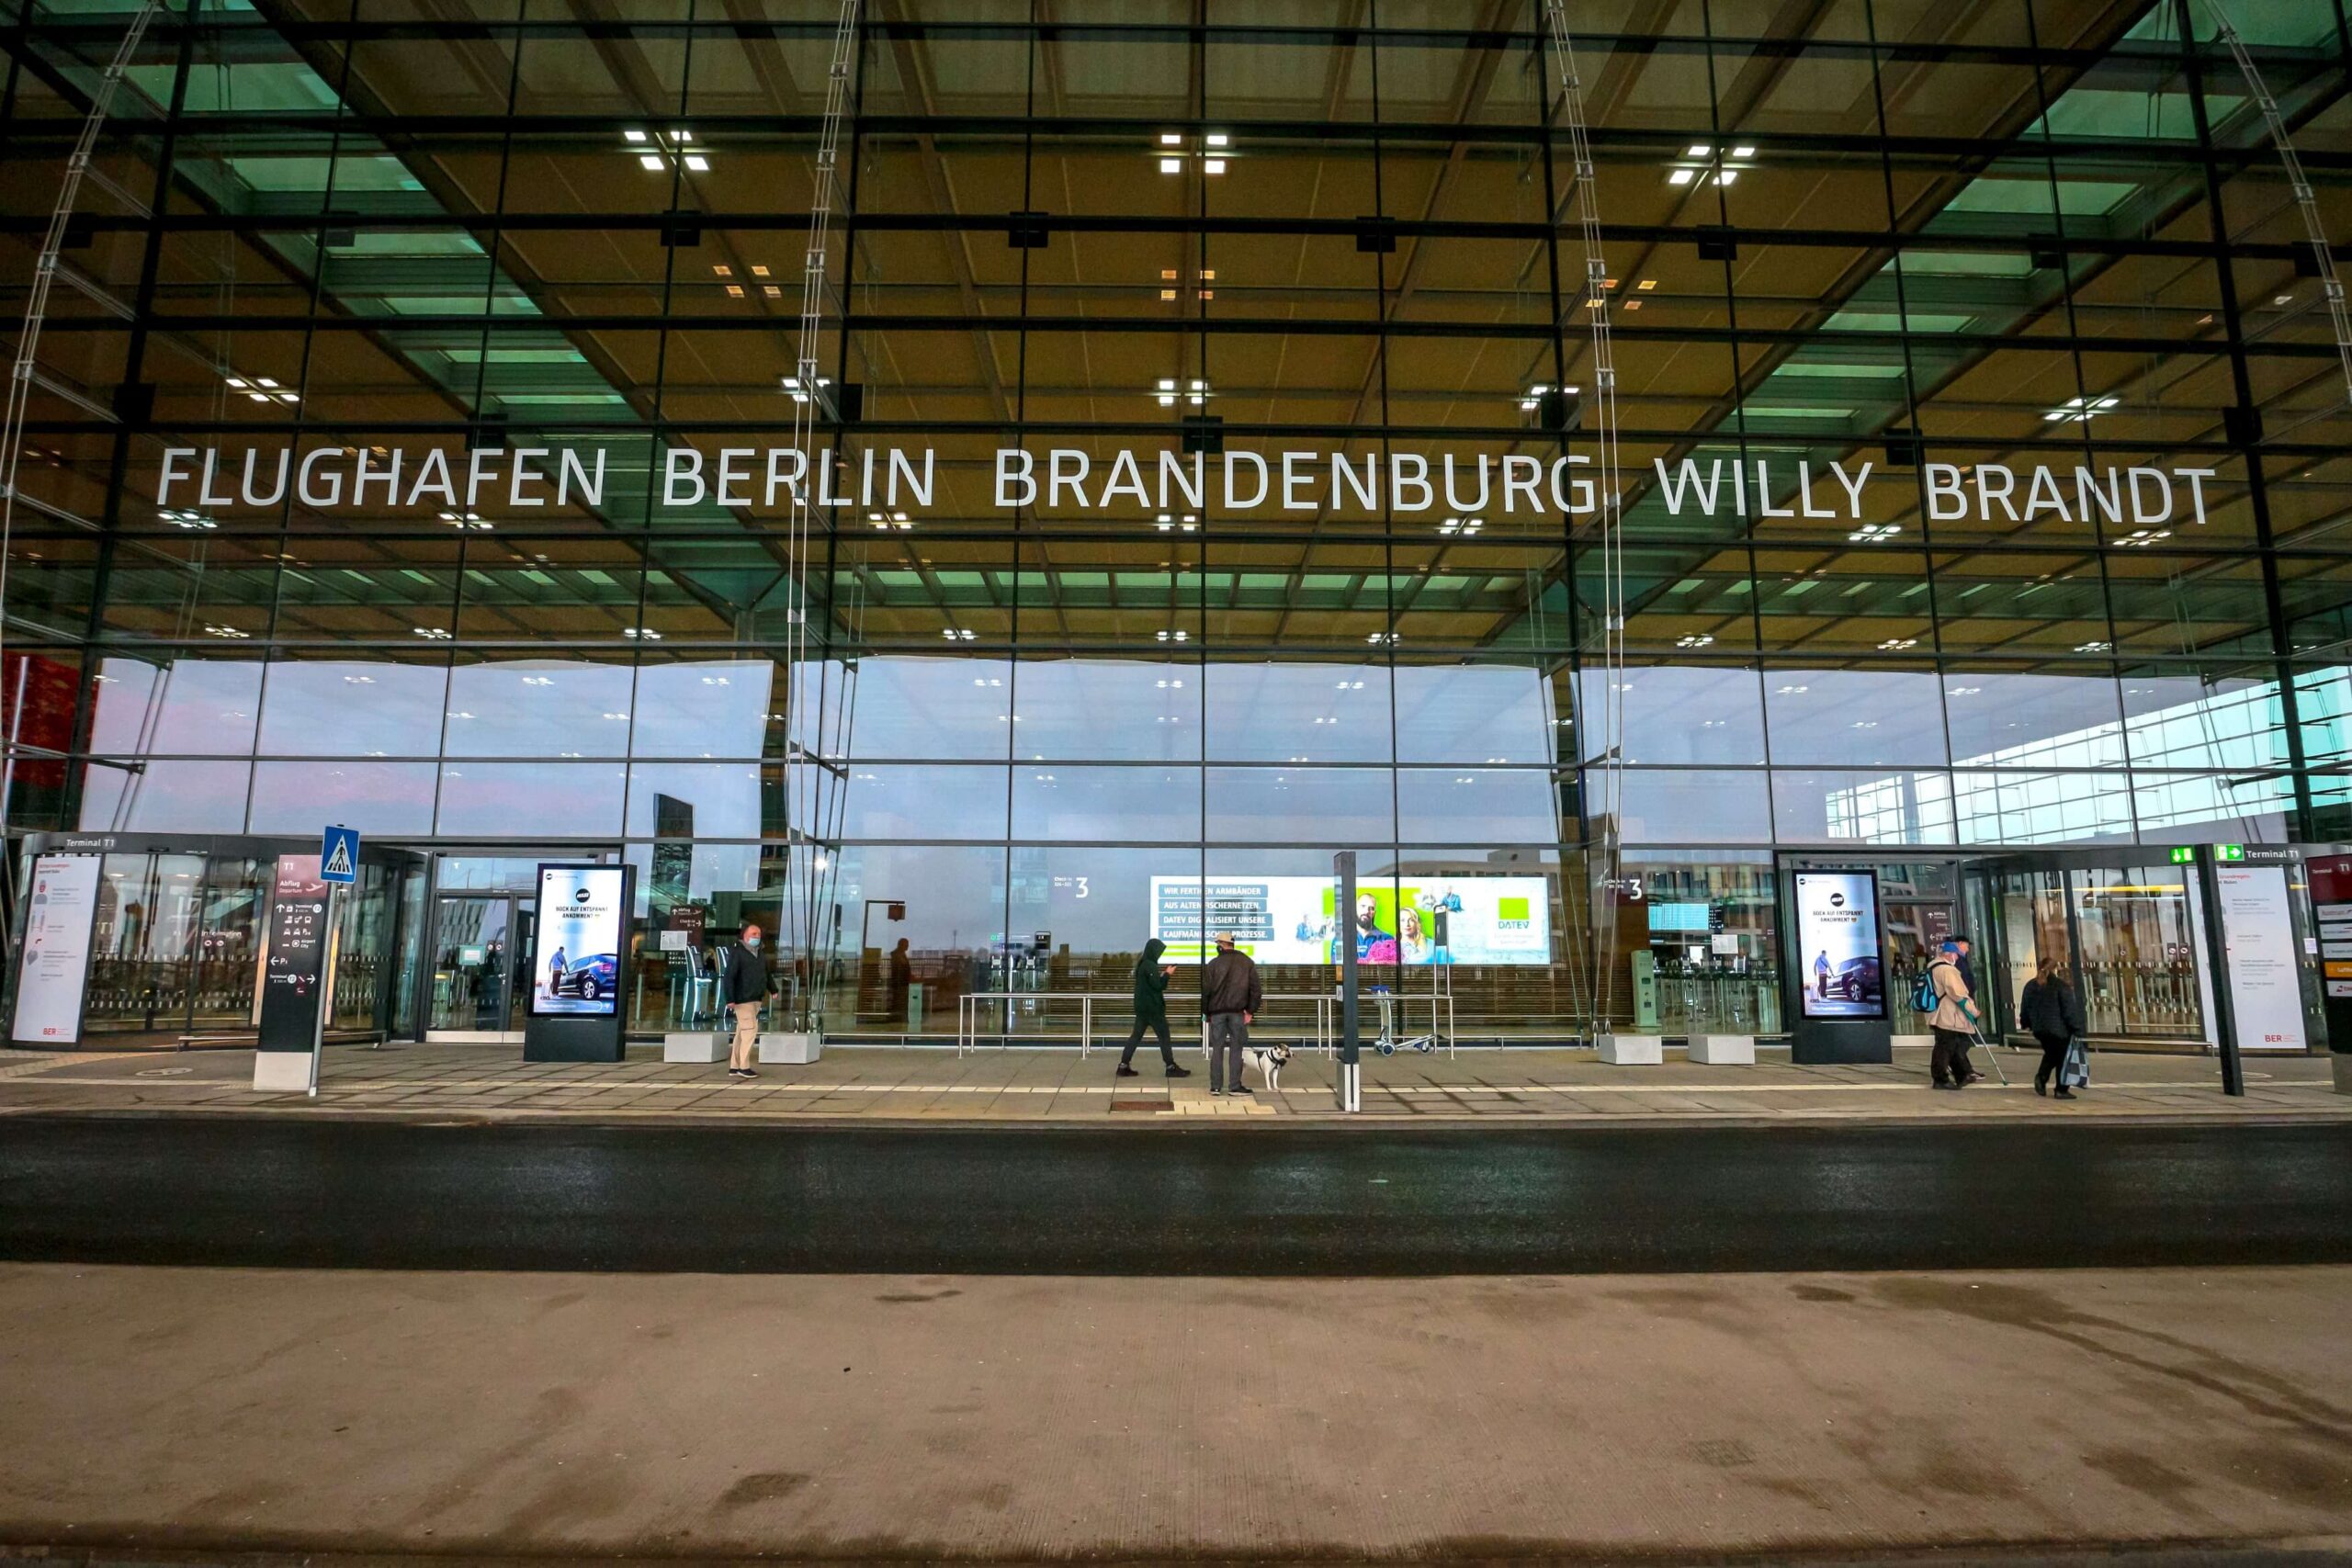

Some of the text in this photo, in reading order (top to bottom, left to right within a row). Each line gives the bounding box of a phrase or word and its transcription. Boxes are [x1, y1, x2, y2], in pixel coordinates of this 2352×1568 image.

[157, 448, 2216, 525] FLUGHAFEN BERLIN BRANDENBURG WILLY BRANDT
[2246, 850, 2299, 858] Terminal T1
[284, 863, 294, 871] T1
[1075, 877, 1089, 898] 3
[1216, 886, 1261, 895] ARMBÄNDER
[1629, 879, 1642, 900] 3
[1164, 901, 1178, 909] AUS
